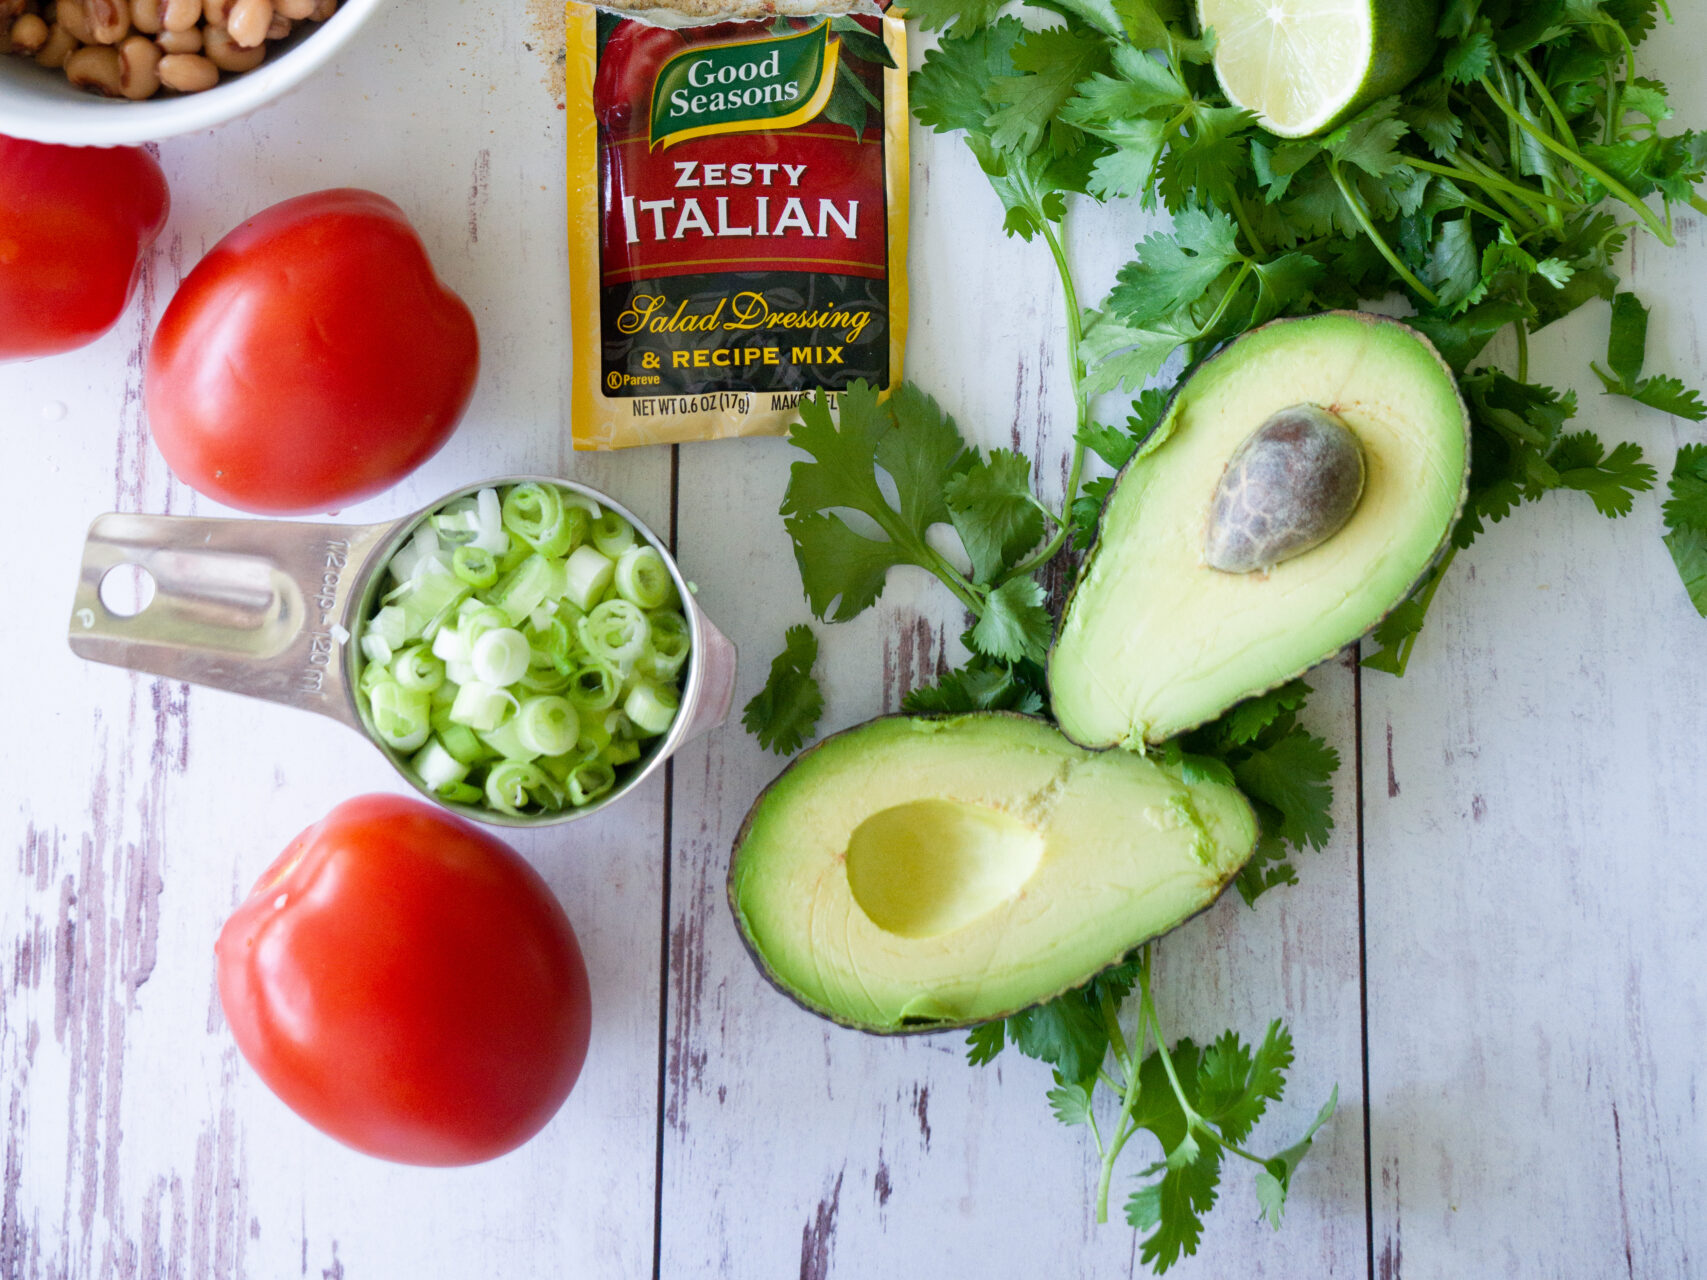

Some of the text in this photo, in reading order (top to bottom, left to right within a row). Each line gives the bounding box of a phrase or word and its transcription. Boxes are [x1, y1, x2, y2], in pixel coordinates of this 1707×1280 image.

[687, 50, 780, 89] Good
[669, 80, 800, 118] Seasons
[674, 160, 808, 188] ZESTY
[623, 195, 860, 244] ITALIAN
[617, 291, 871, 343] Salad Dressing
[641, 346, 845, 369] & RECIPE MIX
[623, 374, 661, 386] Pareve
[632, 398, 657, 416] NET
[658, 398, 677, 415] WT
[679, 397, 699, 414] 0.6
[700, 395, 717, 411] OZ
[719, 393, 751, 415] (17g)
[325, 538, 351, 569] 1/2
[312, 570, 342, 609] cup
[310, 631, 334, 665] 120
